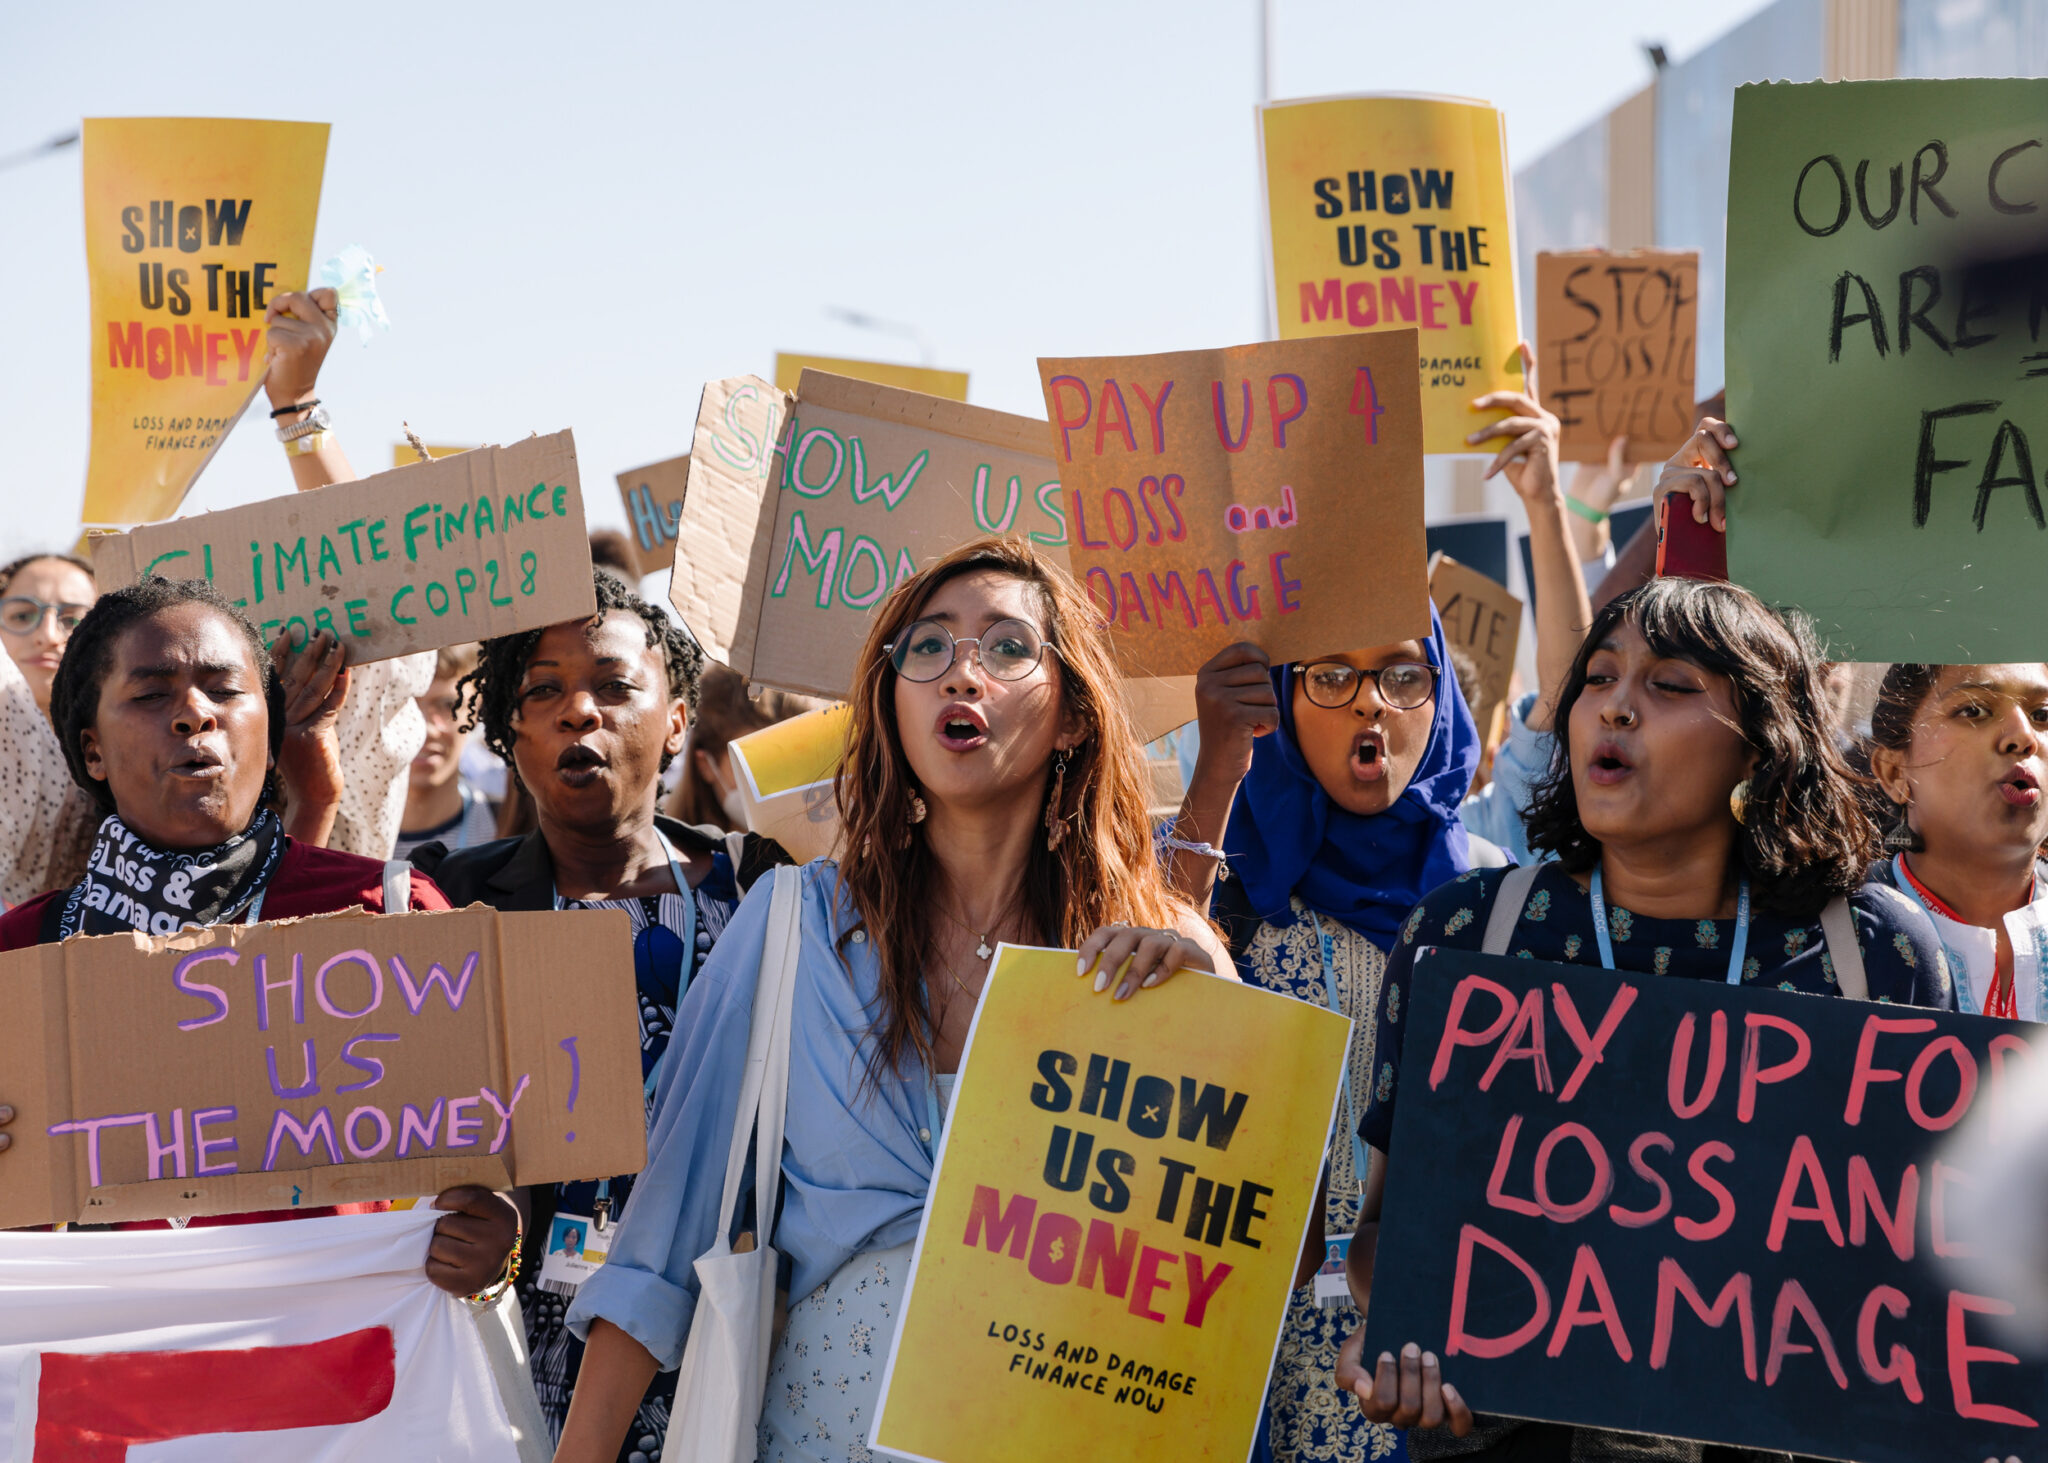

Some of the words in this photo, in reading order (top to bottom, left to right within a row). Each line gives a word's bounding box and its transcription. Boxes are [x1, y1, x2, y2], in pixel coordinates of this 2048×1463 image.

[121, 198, 252, 254] SHOW
[1313, 168, 1454, 219] SHOW
[1794, 139, 1959, 238] OUR
[1988, 139, 2047, 215] C
[1337, 225, 1402, 270] US
[1412, 224, 1490, 272] THE
[139, 262, 191, 317] US
[201, 262, 277, 318] THE
[1299, 276, 1480, 330] MONEY
[1563, 258, 1698, 342] STOP
[107, 321, 261, 386] MONEY
[1420, 357, 1482, 371] DAMAGE
[1432, 374, 1466, 388] NOW
[133, 416, 164, 430] LOSS
[168, 416, 193, 432] AND
[145, 434, 197, 450] FINANCE
[198, 434, 218, 450] NO
[1050, 375, 1174, 462] PAY
[1212, 373, 1308, 453] UP
[1348, 367, 1385, 445] 4
[711, 384, 930, 511] SHOW
[973, 464, 1068, 546] US
[1913, 400, 2048, 534] FA
[628, 482, 683, 553] Hu
[1072, 474, 1187, 551] LOSS
[1224, 485, 1298, 534] and
[391, 550, 538, 625] COP28
[1086, 551, 1303, 632] DAMAGE
[1431, 585, 1507, 661] ATE
[95, 840, 157, 892] Loss
[163, 871, 195, 910] &
[173, 947, 480, 1032] SHOW
[265, 1033, 401, 1100] US
[1429, 974, 1639, 1103] PAY
[1667, 1009, 1813, 1123] UP
[47, 1106, 239, 1188] THE
[262, 1074, 531, 1172] MONEY
[1030, 1049, 1250, 1152] SHOW
[1042, 1124, 1137, 1214] US
[1155, 1156, 1275, 1250] THE
[1486, 1114, 1736, 1242] LOSS
[962, 1184, 1234, 1329] MONEY
[987, 1320, 1045, 1352] LOSS
[1053, 1339, 1099, 1365] AND
[1107, 1352, 1197, 1397] DAMAGE
[1446, 1223, 2041, 1429] DAMAGE
[1008, 1353, 1108, 1396] FINANCE
[1115, 1385, 1165, 1415] NOW
